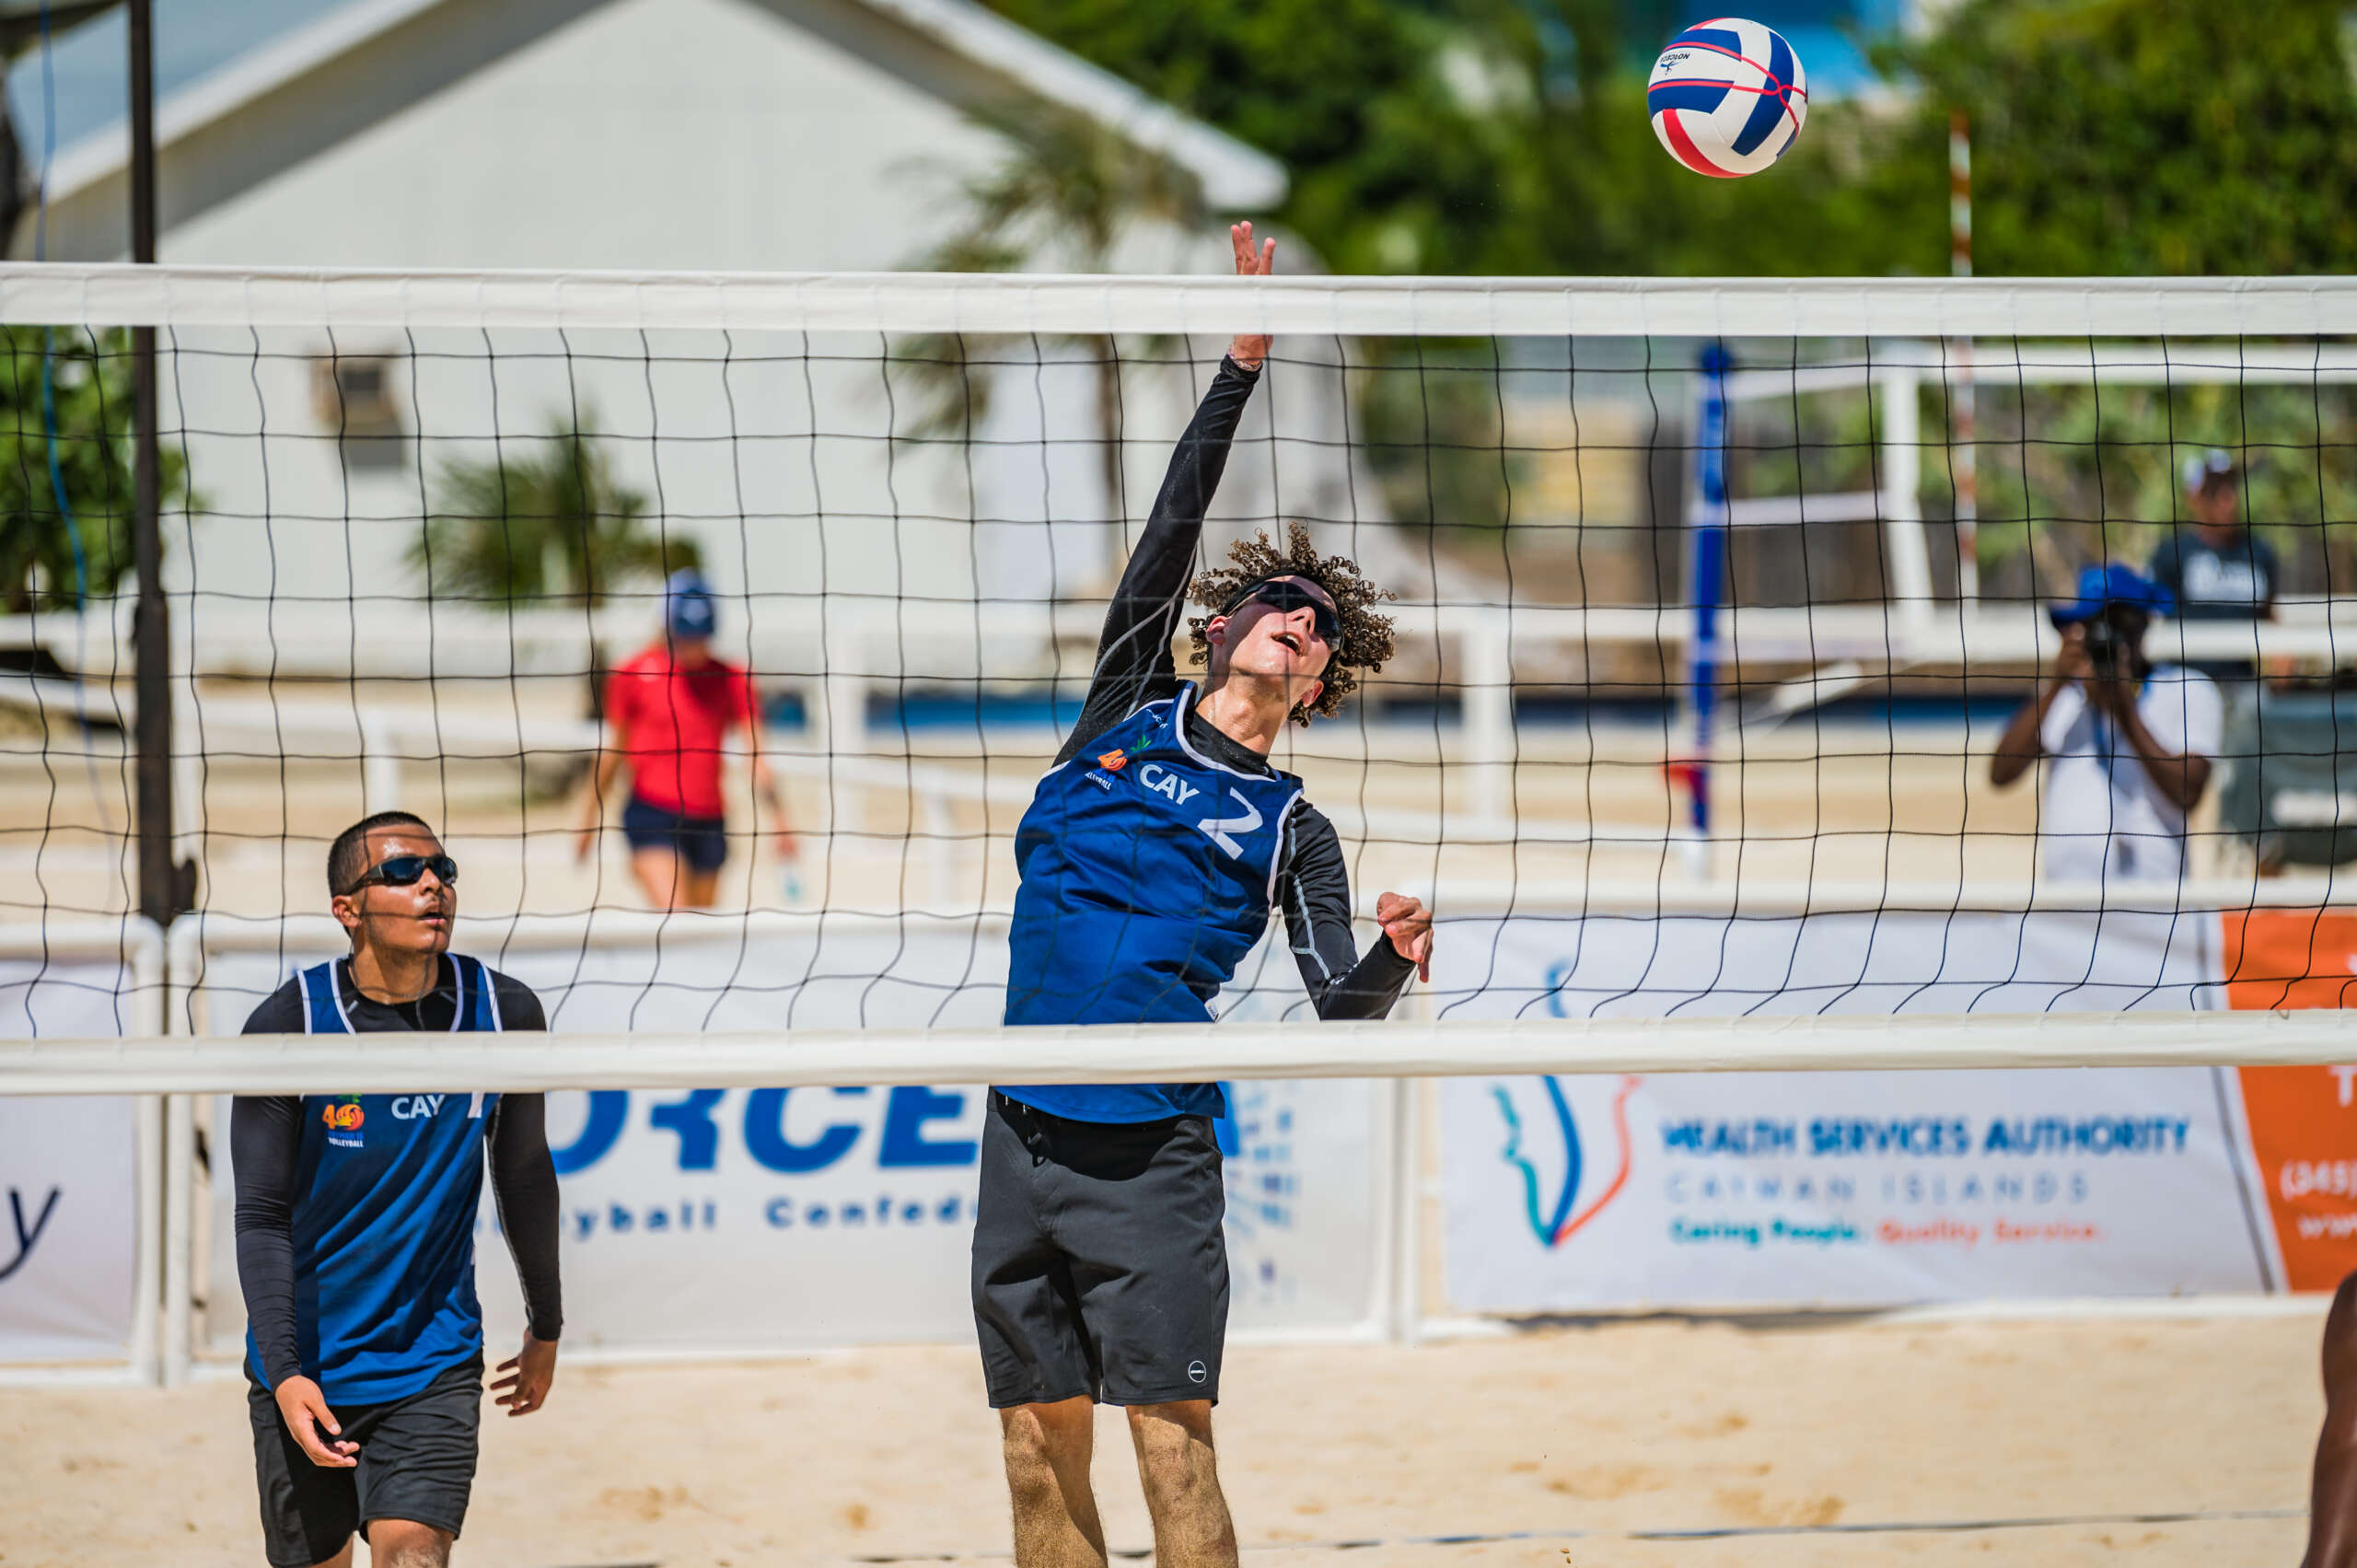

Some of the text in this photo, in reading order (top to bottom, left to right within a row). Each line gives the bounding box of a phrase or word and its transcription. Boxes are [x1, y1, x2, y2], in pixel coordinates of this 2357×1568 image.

[1139, 763, 1201, 806] CAY
[1197, 786, 1264, 861] 2
[390, 1093, 446, 1121] CAY
[1808, 1114, 1970, 1156] SERVICES
[1983, 1115, 2189, 1156] AUTHORITY
[1882, 1171, 2089, 1204] ISLANDS
[560, 1194, 979, 1241] yball Confed
